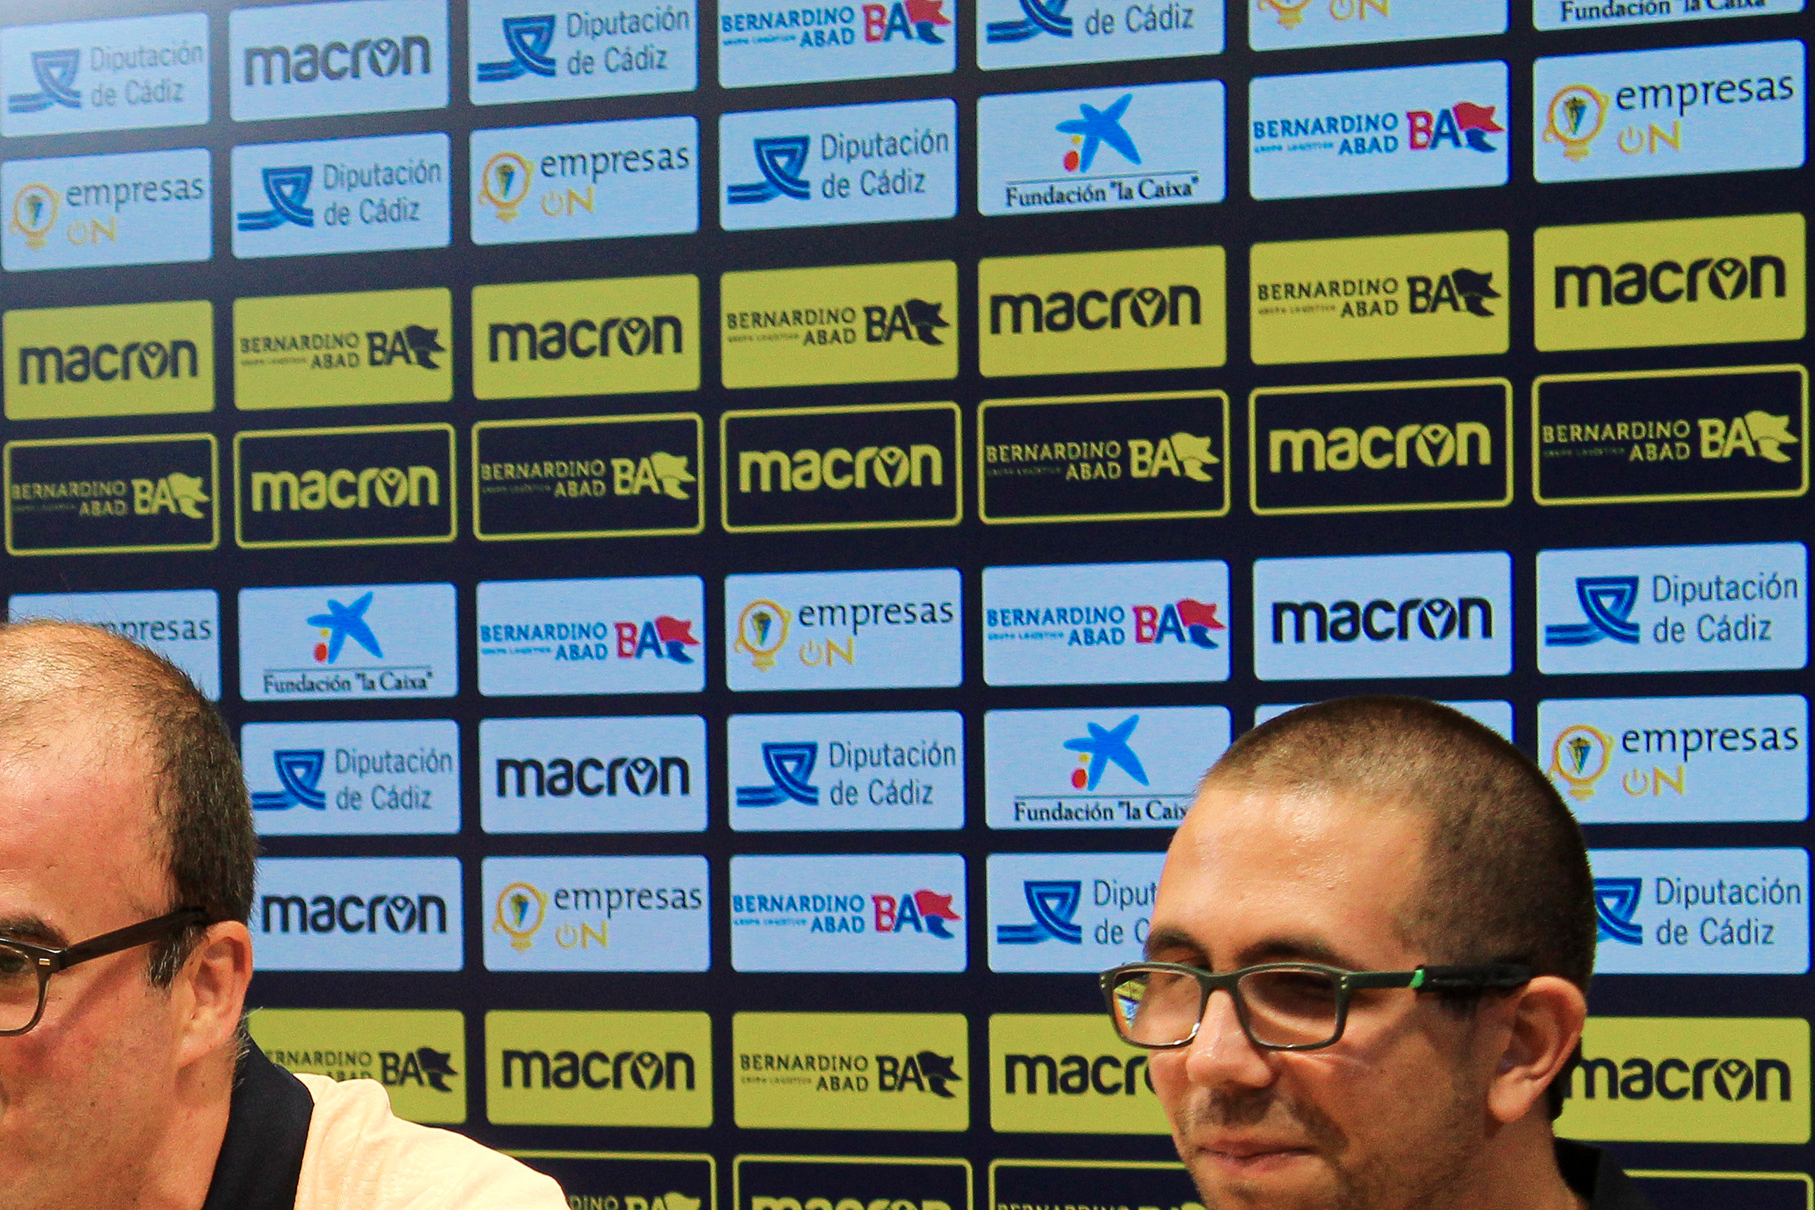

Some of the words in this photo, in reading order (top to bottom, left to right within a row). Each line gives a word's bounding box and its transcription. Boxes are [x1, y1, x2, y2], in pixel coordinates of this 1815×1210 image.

[566, 5, 690, 41] Diputación
[721, 6, 855, 33] BERNARDINO
[1085, 8, 1115, 35] de
[1125, 1, 1195, 32] Cádiz
[799, 27, 855, 48] ABAD
[90, 40, 205, 75] Diputación
[245, 35, 431, 87] macron
[567, 50, 595, 77] de
[604, 45, 667, 74] Cádiz
[91, 84, 117, 108] de
[124, 78, 184, 106] Cádiz
[1615, 75, 1794, 117] empresas
[1253, 112, 1399, 140] BERNARDINO
[821, 128, 949, 164] Diputación
[1338, 135, 1399, 156] ABAD
[323, 159, 442, 192] Diputación
[540, 146, 690, 184] empresas
[66, 177, 204, 213] empresas
[821, 173, 850, 200] de
[859, 168, 926, 197] Cádiz
[1005, 185, 1107, 208] Fundación
[323, 202, 351, 227] de
[359, 197, 420, 225] Cádiz
[1257, 277, 1399, 301] BERNARDINO
[1554, 254, 1786, 309] macron
[726, 306, 857, 330] BERNARDINO
[990, 284, 1201, 335] macron
[1340, 299, 1399, 318] ABAD
[240, 332, 360, 354] BERNARDINO
[489, 315, 683, 363] macron
[803, 328, 857, 346] ABAD
[19, 339, 199, 386] macron
[1542, 419, 1691, 444] BERNARDINO
[985, 440, 1122, 463] BERNARDINO
[1269, 421, 1492, 473] macron
[1629, 441, 1691, 462] ABAD
[480, 458, 606, 481] BERNARDINO
[738, 444, 943, 493] macron
[1065, 460, 1122, 481] ABAD
[11, 479, 127, 500] BERNARDINO
[251, 465, 440, 512] macron
[554, 479, 607, 498] ABAD
[1652, 572, 1798, 607] Diputación
[798, 602, 954, 636] empresas
[987, 605, 1125, 627] BERNARDINO
[1271, 597, 1493, 644] macron
[1652, 616, 1685, 644] de
[1696, 613, 1772, 643] Cádiz
[480, 621, 608, 643] BERNARDINO
[1068, 627, 1126, 646] ABAD
[555, 643, 608, 661] ABAD
[263, 673, 352, 694] Fundación
[829, 741, 956, 772] Diputación
[1621, 726, 1799, 763] empresas
[334, 747, 453, 778] Diputación
[496, 756, 690, 798] macron
[335, 786, 363, 811] de
[370, 784, 432, 811] Cádiz
[829, 780, 859, 807] de
[868, 778, 933, 806] Cádiz
[1014, 801, 1114, 822] Fundación
[553, 888, 702, 919] empresas
[732, 894, 865, 913] BERNARDINO
[1655, 876, 1801, 910] Diputación
[261, 894, 447, 934] macron
[810, 915, 865, 934] ABAD
[1094, 918, 1124, 945] de
[1655, 918, 1688, 946] de
[1699, 917, 1774, 946] Cádiz
[502, 1049, 696, 1091] macron
[740, 1054, 869, 1072] BERNARDINO
[1005, 1054, 1157, 1096] macr
[816, 1075, 869, 1092] ABAD
